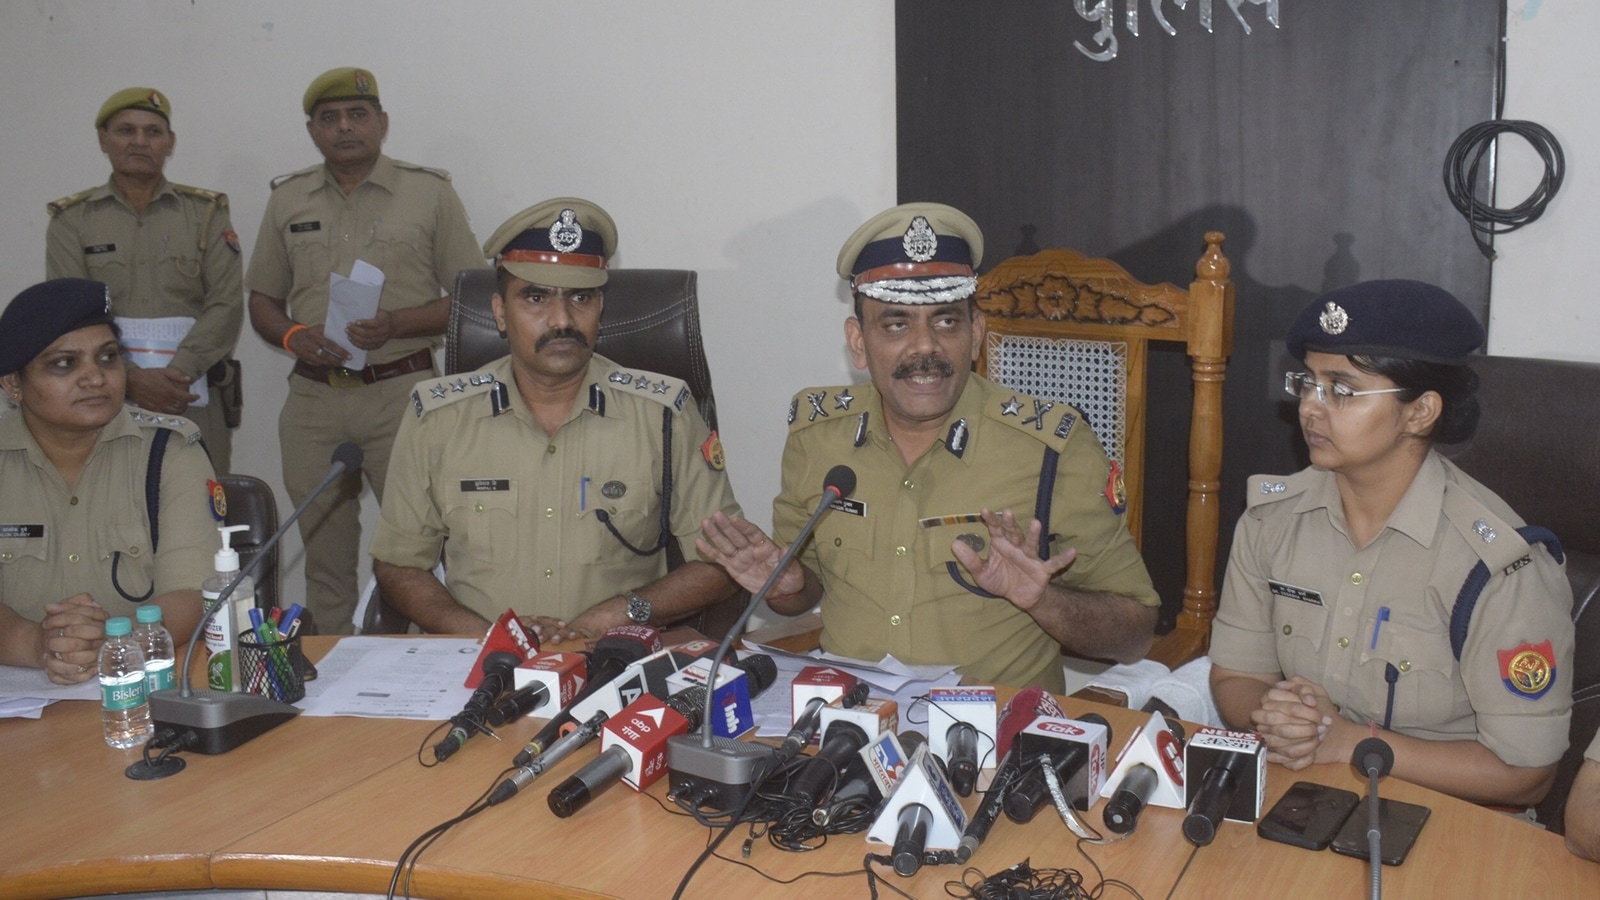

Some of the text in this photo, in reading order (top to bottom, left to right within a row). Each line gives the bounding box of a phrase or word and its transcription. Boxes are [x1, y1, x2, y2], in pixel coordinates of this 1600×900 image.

[112, 683, 143, 702] Bisleri
[630, 717, 651, 734] abp
[1044, 722, 1079, 736] Tak
[621, 726, 641, 741] गंगा
[1200, 728, 1257, 740] NEWS
